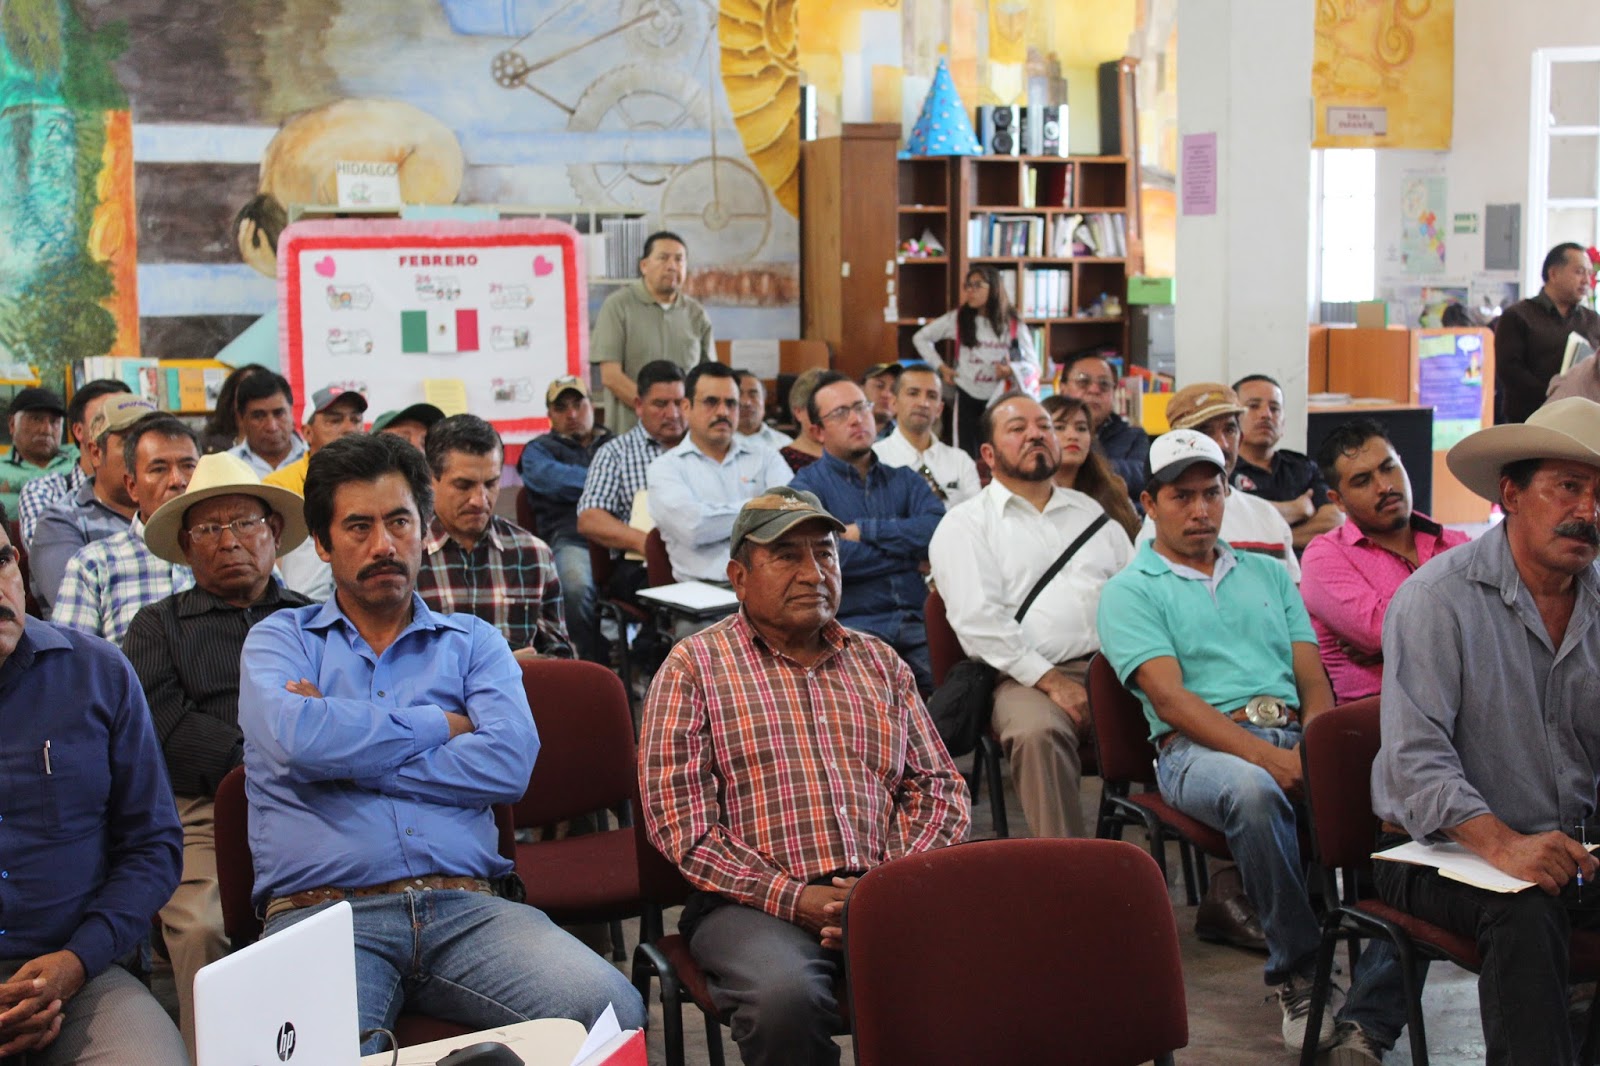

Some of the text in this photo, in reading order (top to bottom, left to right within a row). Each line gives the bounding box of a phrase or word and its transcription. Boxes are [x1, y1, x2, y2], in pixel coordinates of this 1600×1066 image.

[336, 162, 398, 176] HIDALGO
[399, 255, 478, 267] FEBRERO
[280, 1022, 295, 1061] hp
